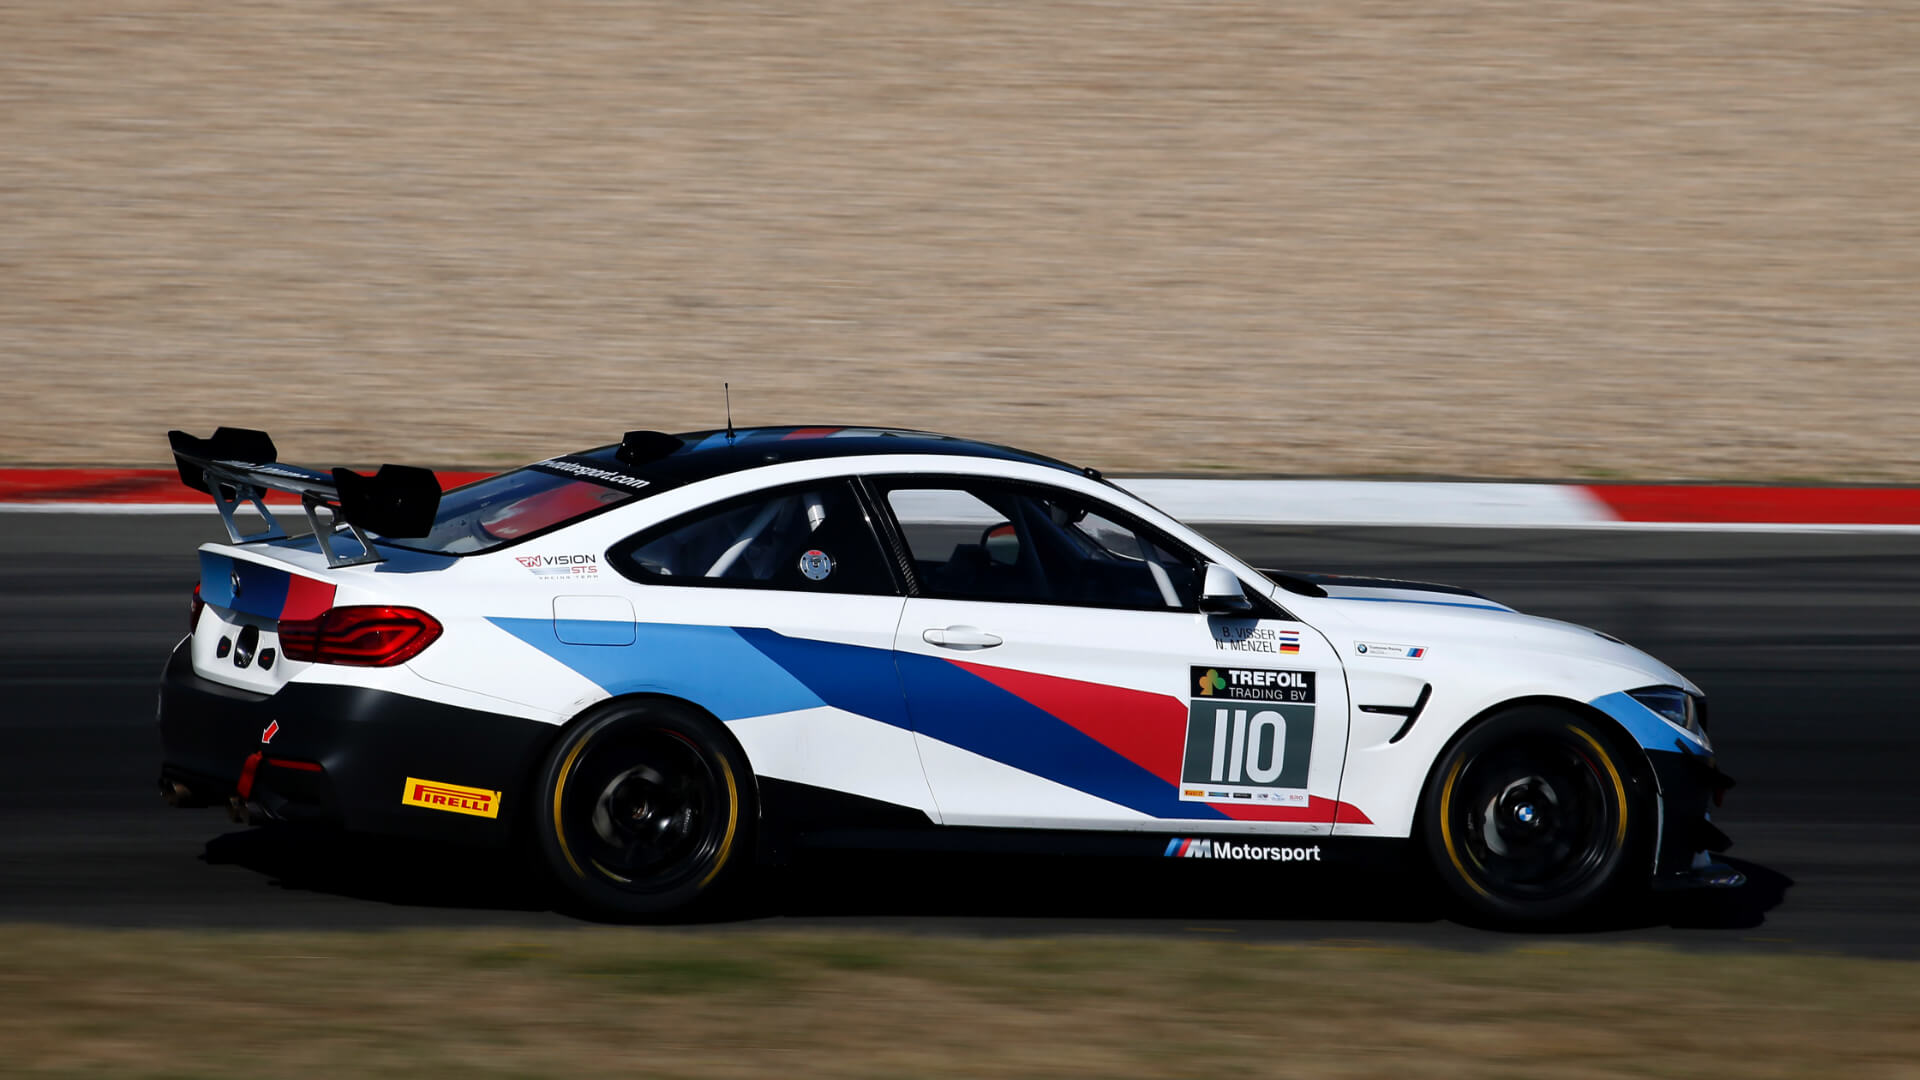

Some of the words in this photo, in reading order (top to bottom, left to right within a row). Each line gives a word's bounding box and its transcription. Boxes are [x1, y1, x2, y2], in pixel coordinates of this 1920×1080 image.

[543, 554, 597, 565] VISION
[571, 566, 598, 574] STS
[1222, 626, 1234, 639] B.
[1235, 627, 1276, 640] VISSER
[1215, 638, 1228, 650] N.
[1230, 639, 1277, 653] MENZEL
[1228, 669, 1308, 688] TREFOIL
[1228, 687, 1283, 700] TRADING
[1290, 690, 1307, 701] BV
[1210, 708, 1287, 784] 110
[413, 784, 492, 812] PIRELLI
[1213, 841, 1321, 862] Motorsport
